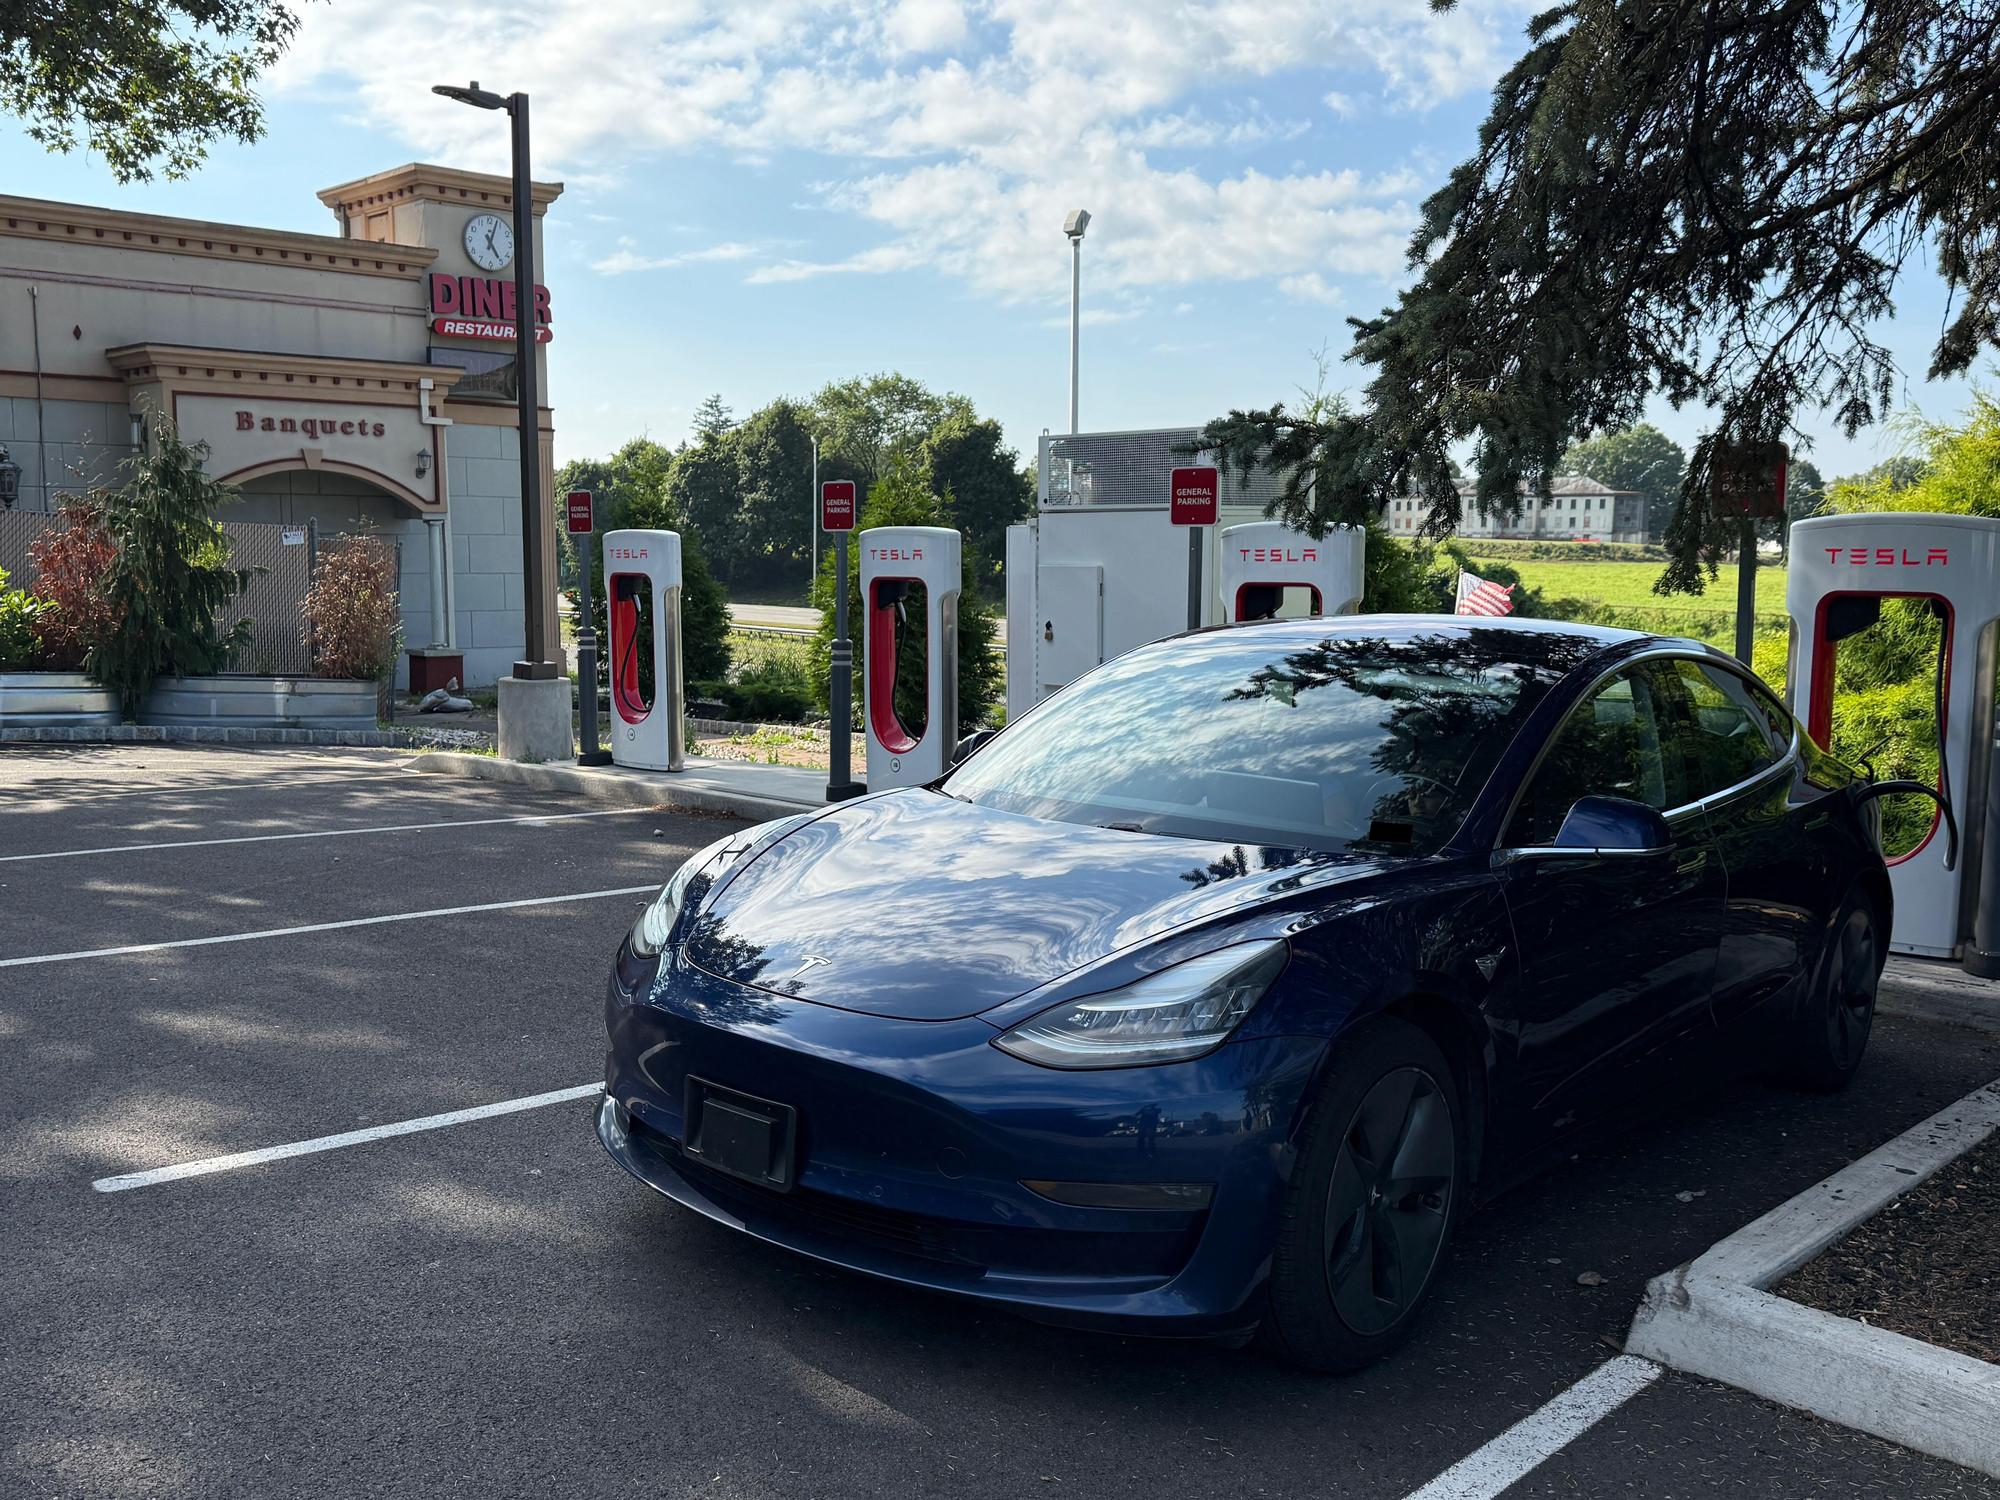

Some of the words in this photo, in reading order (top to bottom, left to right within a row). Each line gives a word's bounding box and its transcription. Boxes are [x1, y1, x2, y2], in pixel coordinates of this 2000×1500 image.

[429, 273, 552, 323] DINER
[444, 321, 544, 341] RESTAURT
[235, 411, 385, 440] Banquets
[1176, 488, 1212, 496] GENERAL
[826, 498, 851, 506] GENERAL
[1177, 497, 1211, 506] PARKING
[827, 506, 850, 514] PARKING
[609, 549, 648, 559] TESLA
[870, 549, 923, 560] TESLA
[1239, 549, 1317, 562] TESLA
[1825, 548, 1949, 566] TESLA
